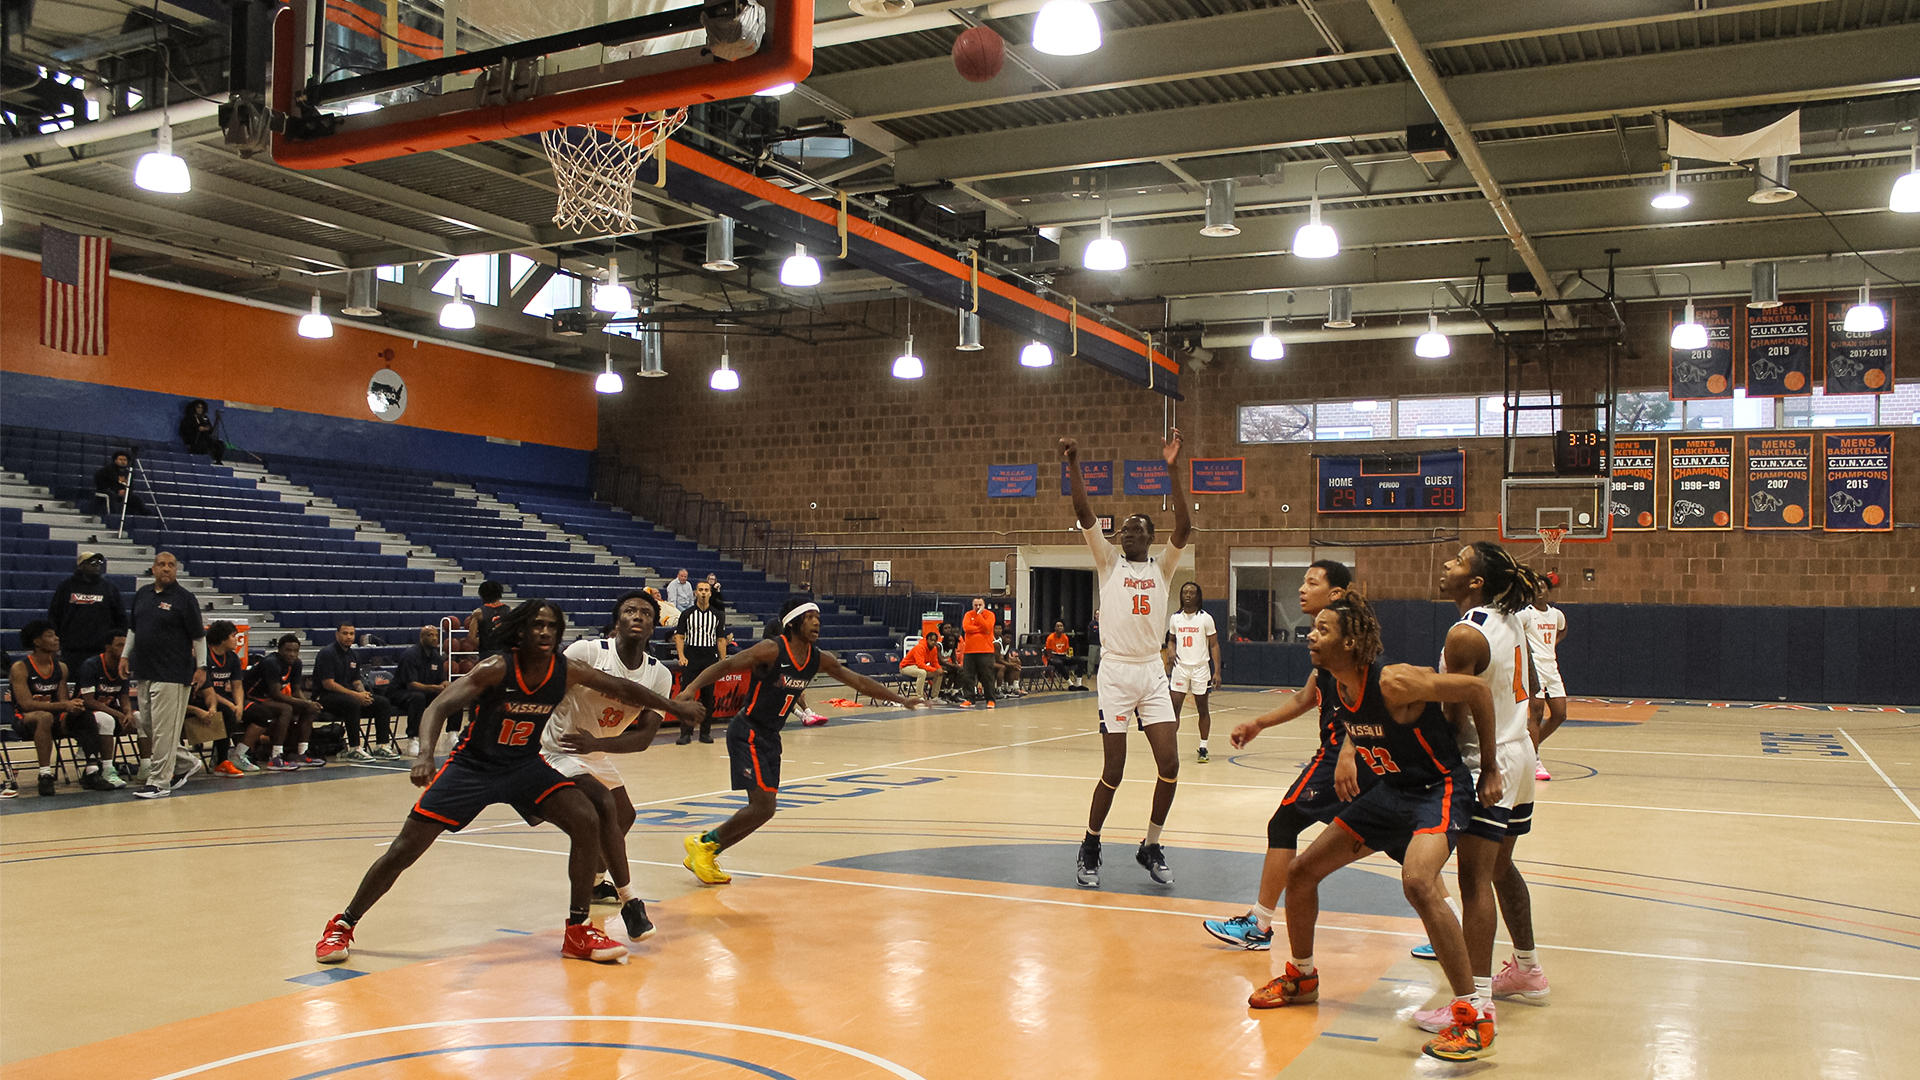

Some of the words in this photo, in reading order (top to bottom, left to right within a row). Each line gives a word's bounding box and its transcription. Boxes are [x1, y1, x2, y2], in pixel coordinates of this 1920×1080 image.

[1695, 310, 1718, 319] ENS
[1762, 306, 1796, 315] MENS
[1749, 314, 1809, 323] BASKETBALL
[1751, 326, 1807, 335] C.U.N.Y.A.C.
[1845, 331, 1872, 339] CLUB
[1750, 337, 1809, 349] CHAMPIONS
[1691, 350, 1712, 359] 2018
[1768, 346, 1790, 356] 2019
[1569, 433, 1597, 446] 3:13
[1761, 440, 1796, 449] MENS
[1840, 438, 1876, 448] MENS
[1673, 447, 1730, 455] BASKETBALL
[1748, 448, 1809, 456] BASKETBALL
[1827, 447, 1890, 455] BASKETBALL
[1672, 457, 1730, 466] C.U.N.Y.A.C.
[1750, 460, 1806, 468] C.U.N.Y.A.C.
[1828, 459, 1887, 467] C.U.N.Y.A.C.
[1613, 469, 1653, 480] AMPIONS
[1673, 467, 1729, 480] CHAMPIONS
[1749, 471, 1808, 481] CHAMPIONS
[1827, 471, 1888, 481] CHAMPIONS
[1328, 478, 1353, 487] HOME
[1424, 476, 1453, 486] GUEST
[1680, 481, 1721, 490] 1998-99
[1767, 479, 1789, 489] 2007
[1846, 479, 1869, 489] 2015
[1431, 487, 1455, 506] 28
[1132, 594, 1151, 615] 15
[235, 632, 245, 646] G
[1183, 636, 1193, 648] 10
[778, 694, 795, 717] 1
[497, 718, 535, 746] 12
